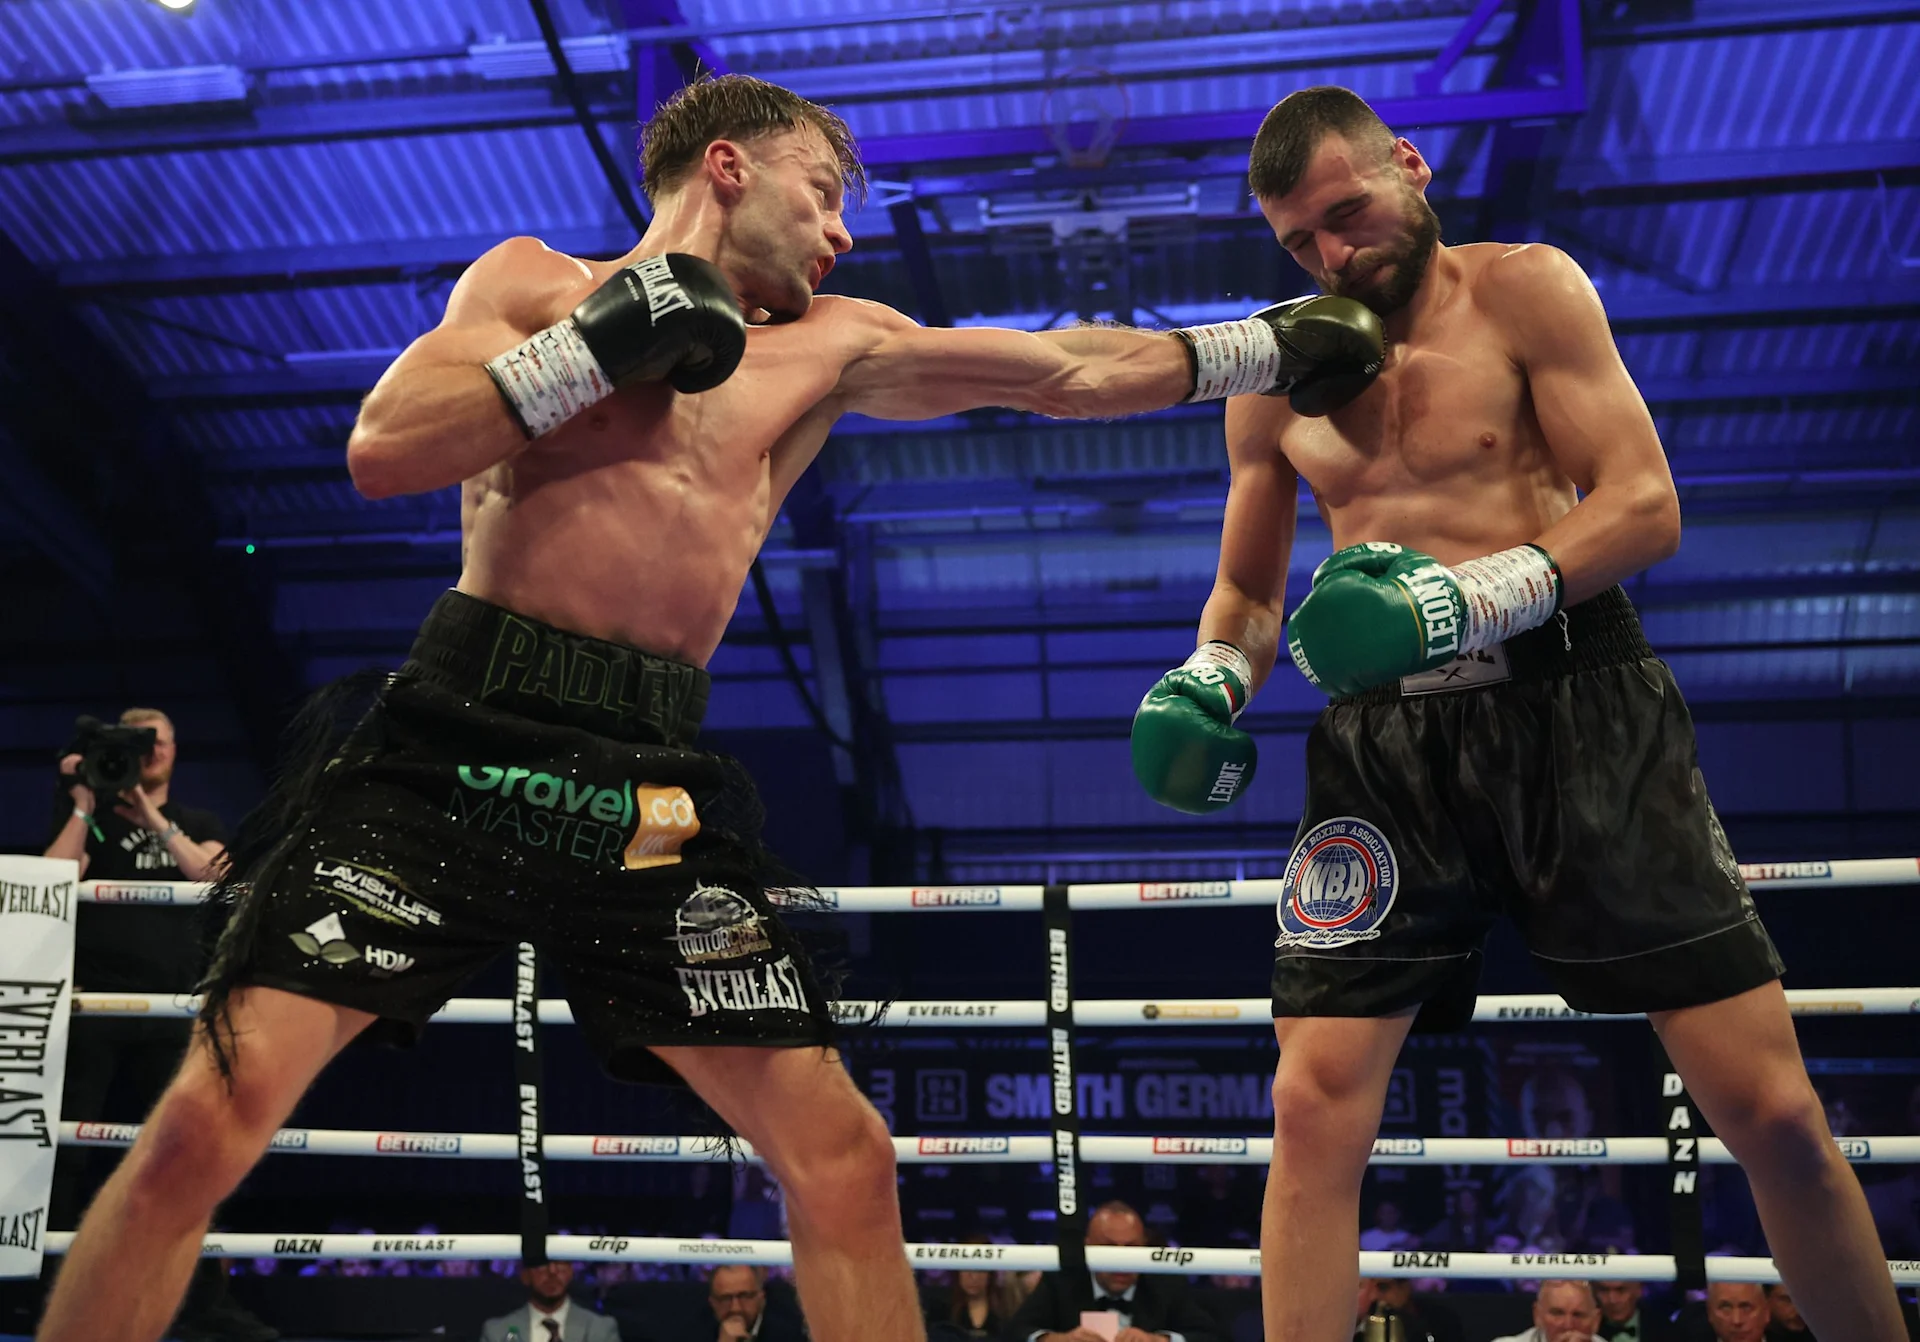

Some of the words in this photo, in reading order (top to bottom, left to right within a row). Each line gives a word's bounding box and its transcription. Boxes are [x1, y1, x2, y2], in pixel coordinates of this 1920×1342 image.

[1288, 638, 1321, 686] LEONE
[481, 614, 695, 743] PADLEY
[1207, 761, 1247, 802] LEONE
[450, 786, 625, 864] MASTER
[1285, 846, 1308, 888] WORLD
[1309, 824, 1347, 846] BOXING
[1349, 825, 1391, 888] ASSOCIATION
[1142, 883, 1231, 900] BETFRED
[1300, 859, 1366, 907] WBA
[0, 880, 73, 922] VERLAST
[314, 861, 396, 903] LAVISH
[398, 895, 443, 926] LIFE
[914, 889, 999, 906] BETFRED
[1049, 928, 1068, 1012] BETFRED
[675, 953, 811, 1018] EVERLAST
[908, 1005, 997, 1018] EVERLAST
[1052, 1027, 1073, 1115] BETFRED
[984, 1073, 1124, 1121] SMTH
[379, 1134, 459, 1153] BETFRED
[519, 1084, 543, 1203] EVERLAST
[595, 1137, 678, 1155] BETFRED
[919, 1138, 1008, 1154] BETFRED
[1155, 1138, 1246, 1154] BETFRED
[1509, 1139, 1605, 1156] BETFRED
[1056, 1129, 1077, 1216] BETFRED
[273, 1238, 323, 1254] DAZN
[372, 1239, 456, 1251] EVERLAST
[589, 1236, 629, 1254] drip
[915, 1246, 1006, 1260] EVERLAST
[1150, 1246, 1195, 1265] drip
[1392, 1252, 1450, 1268] DAZN
[1511, 1253, 1610, 1265] EVERLAST
